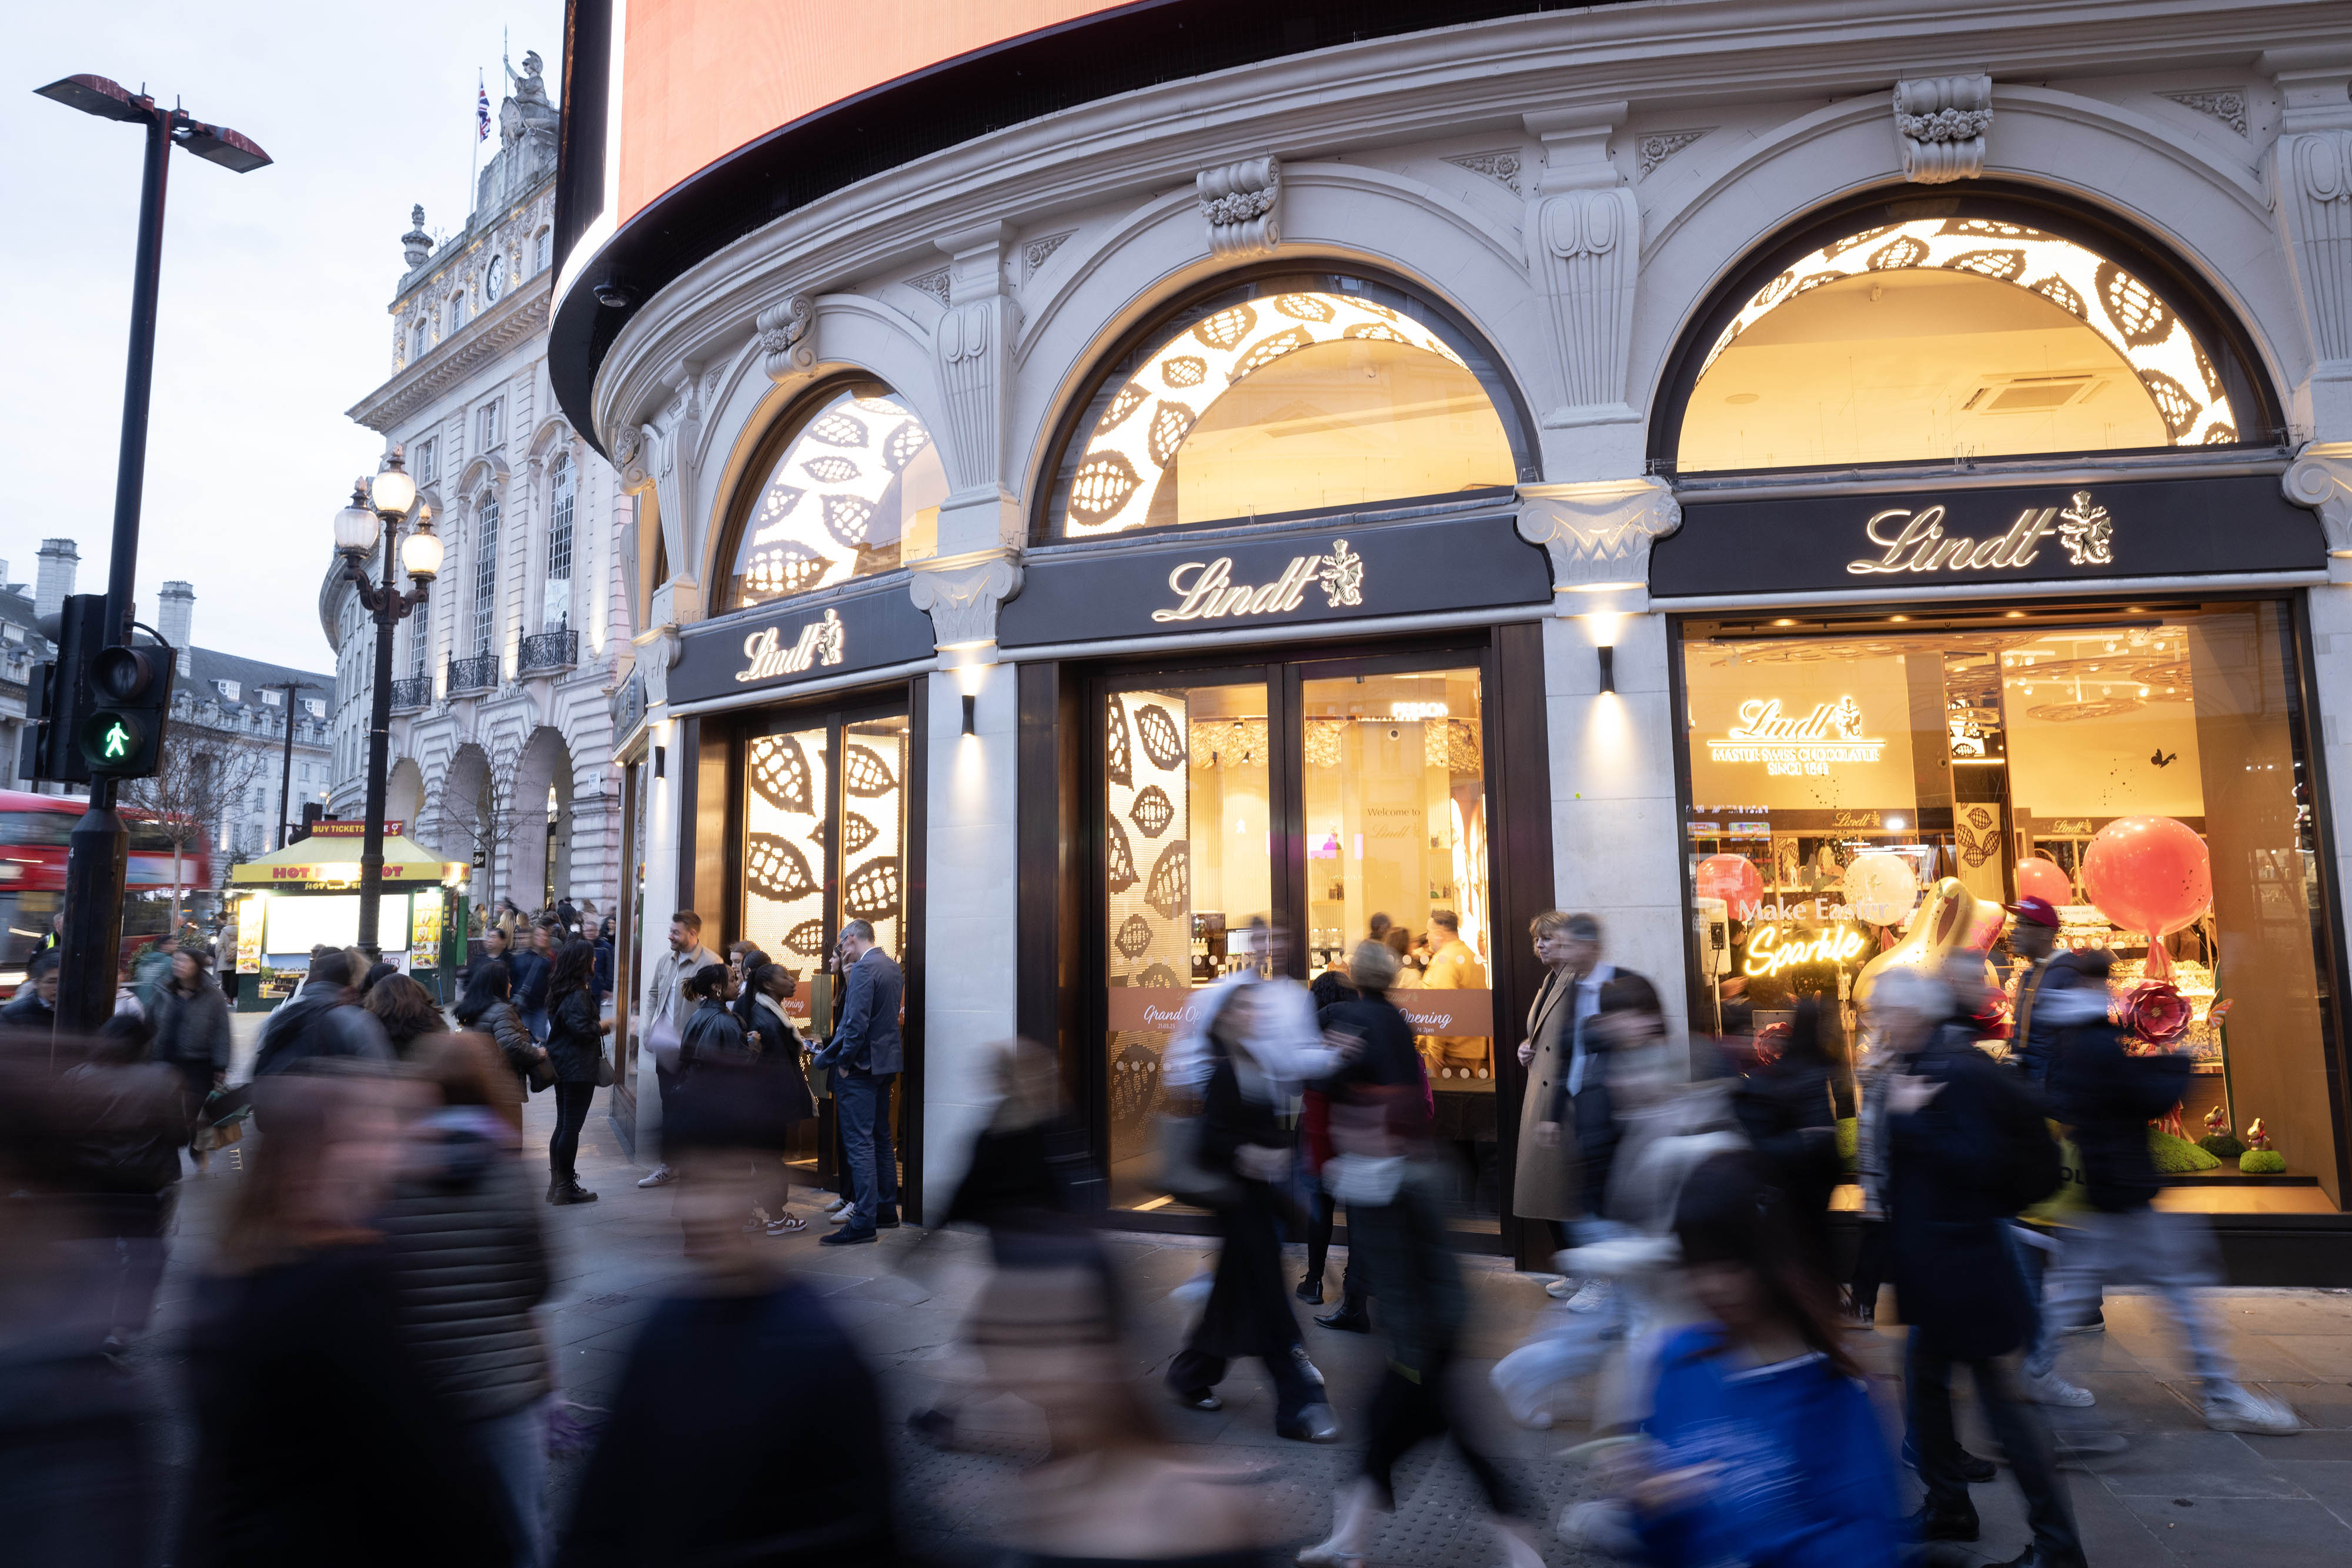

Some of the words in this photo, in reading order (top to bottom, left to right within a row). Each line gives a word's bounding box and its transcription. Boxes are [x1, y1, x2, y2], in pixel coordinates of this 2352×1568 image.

[1847, 505, 2058, 574] Lindt
[1152, 556, 1321, 621] Lindt
[736, 623, 824, 681] Lindt
[1729, 699, 1837, 739] Lindt
[1712, 748, 1760, 761] MASTER
[1762, 748, 1797, 761] SWISS
[1768, 762, 1802, 775] SINCE
[1368, 807, 1409, 816] Welcome
[1832, 812, 1870, 827] Lindt
[2052, 820, 2084, 833] Lindt
[273, 867, 309, 878] HOT
[1739, 897, 1806, 921] Make
[1815, 898, 1889, 920] Easter
[1745, 924, 1865, 977] Sparkle
[1144, 1004, 1182, 1025] Grand
